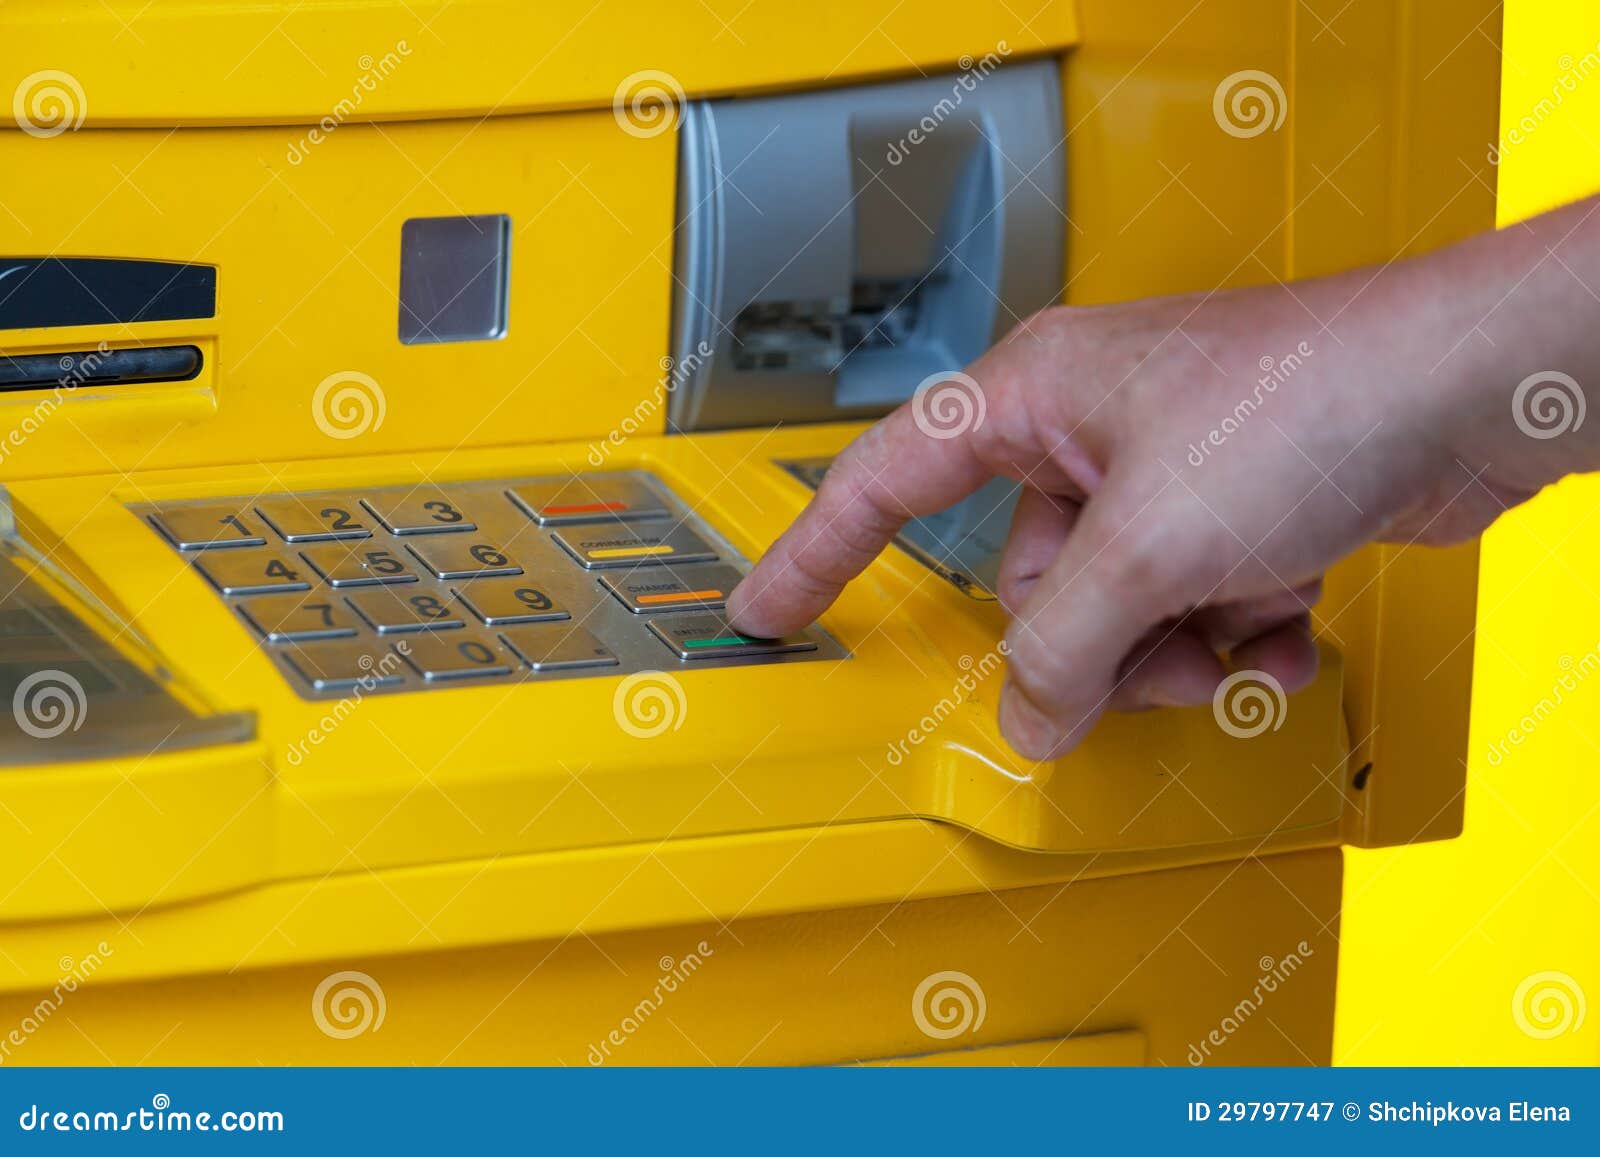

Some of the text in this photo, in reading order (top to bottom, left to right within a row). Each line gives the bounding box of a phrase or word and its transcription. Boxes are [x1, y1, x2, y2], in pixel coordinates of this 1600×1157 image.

[320, 508, 362, 530] 2
[423, 501, 463, 523] 3
[220, 515, 252, 536] 1
[365, 552, 404, 573] 5
[470, 544, 508, 566] 6
[265, 559, 297, 581] 4
[410, 596, 449, 618] 8
[514, 588, 553, 610] 9
[303, 604, 334, 626] 7
[458, 642, 495, 664] 0
